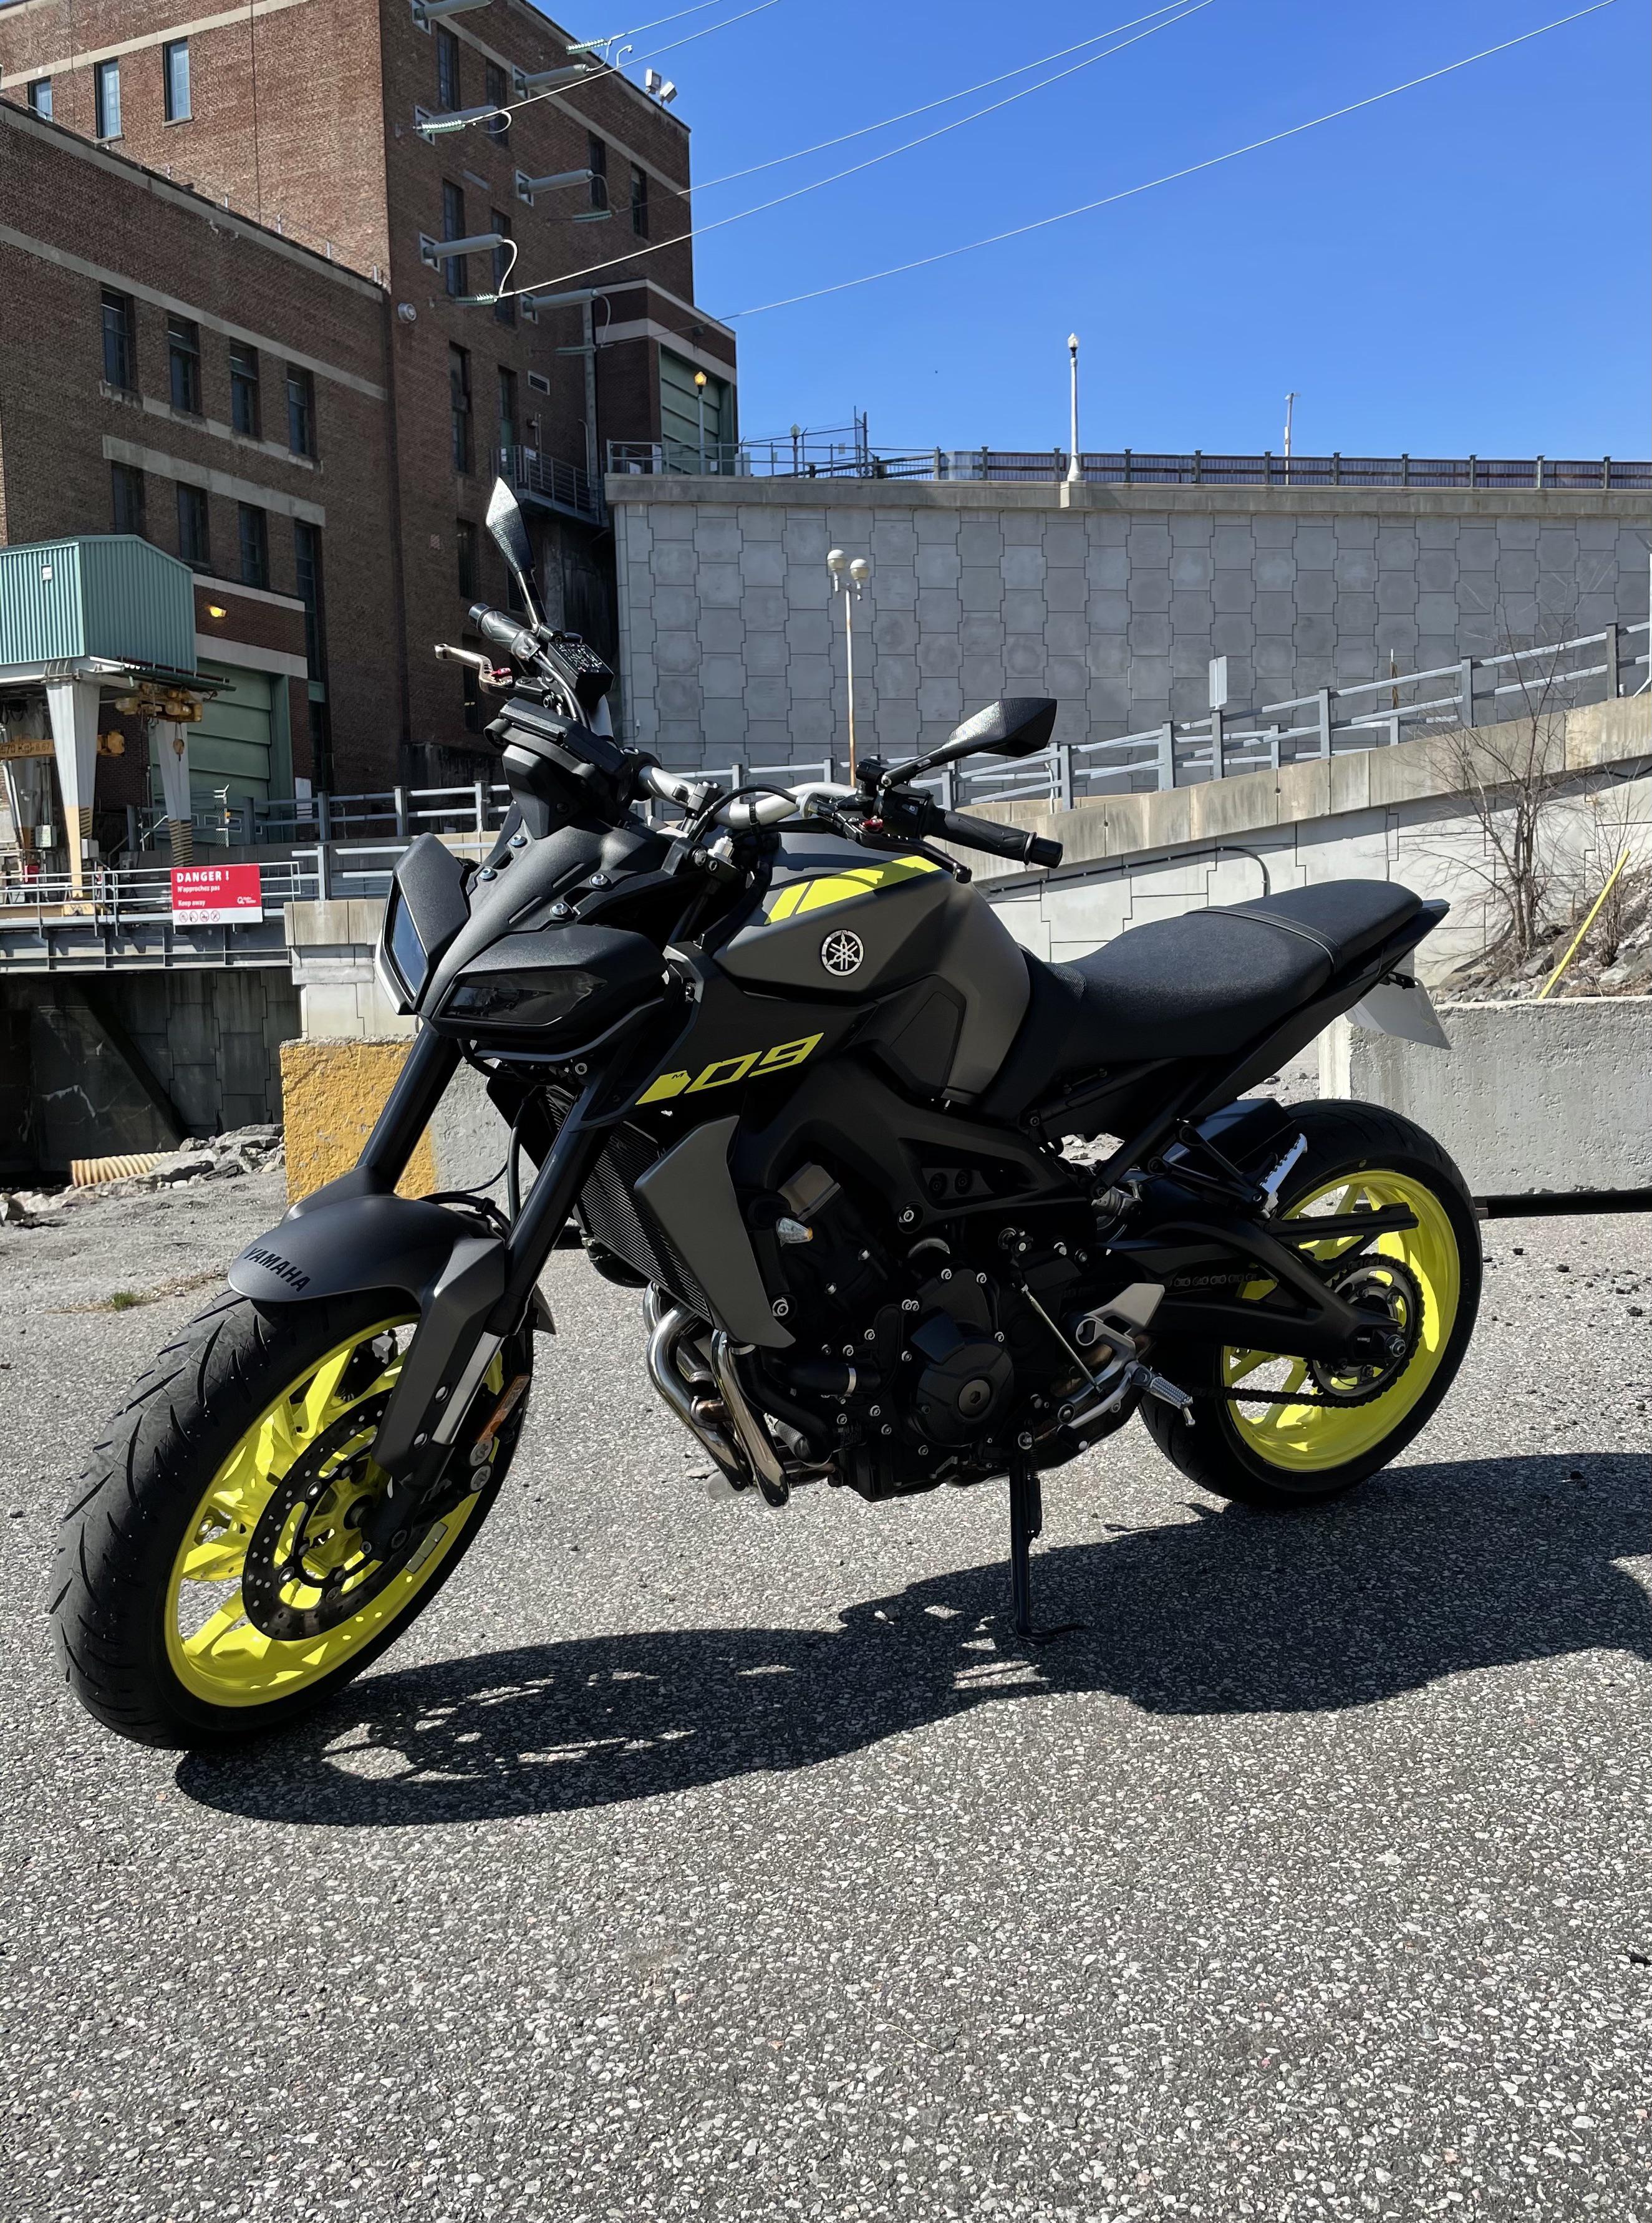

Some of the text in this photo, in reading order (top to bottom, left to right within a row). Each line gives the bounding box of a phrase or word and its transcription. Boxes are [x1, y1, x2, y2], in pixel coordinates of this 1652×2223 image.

[176, 870, 229, 883] DANGER !
[243, 1247, 311, 1292] YAMAHA
